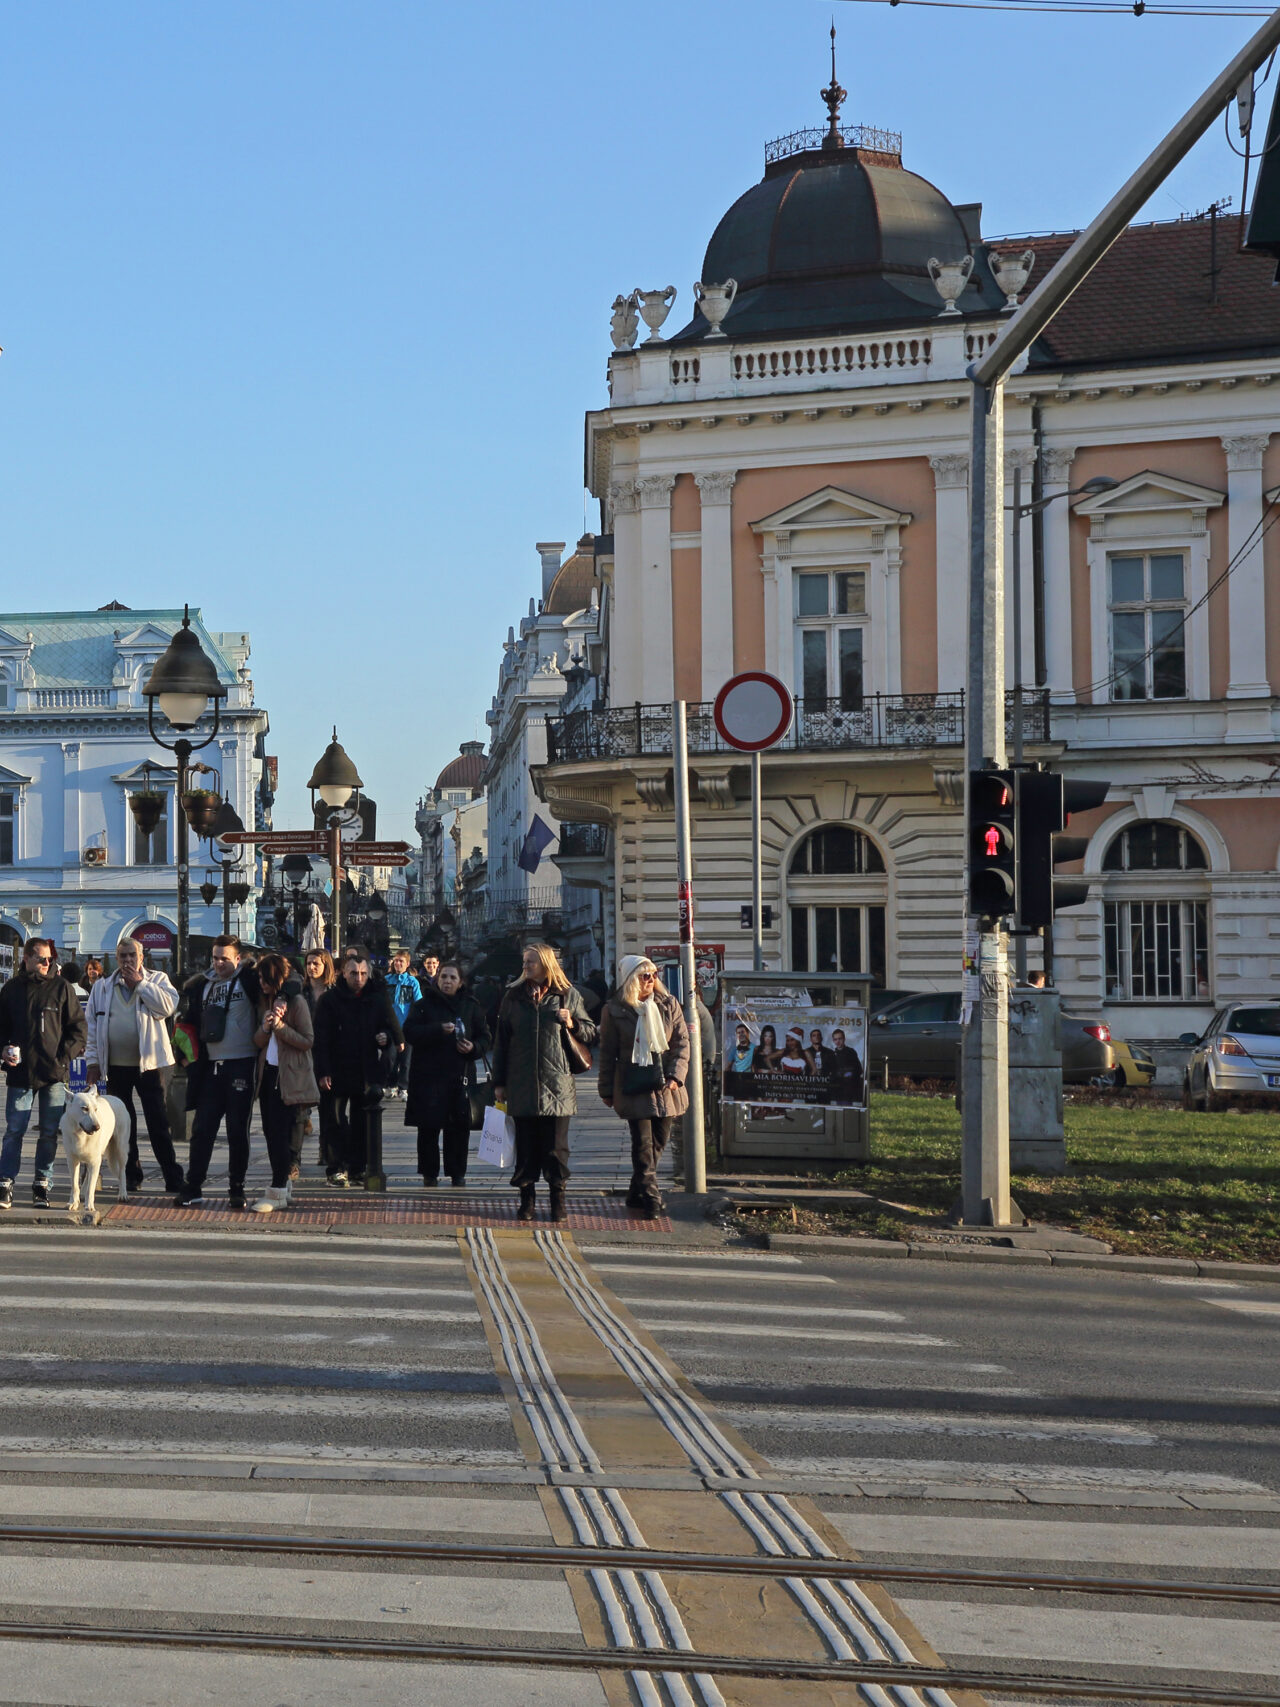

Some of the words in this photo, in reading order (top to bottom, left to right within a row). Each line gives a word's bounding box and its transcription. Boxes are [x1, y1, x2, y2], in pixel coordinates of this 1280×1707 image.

[726, 1012, 785, 1023] HANGOVER
[787, 1014, 837, 1025] FACTORY
[839, 1017, 862, 1027] 2015
